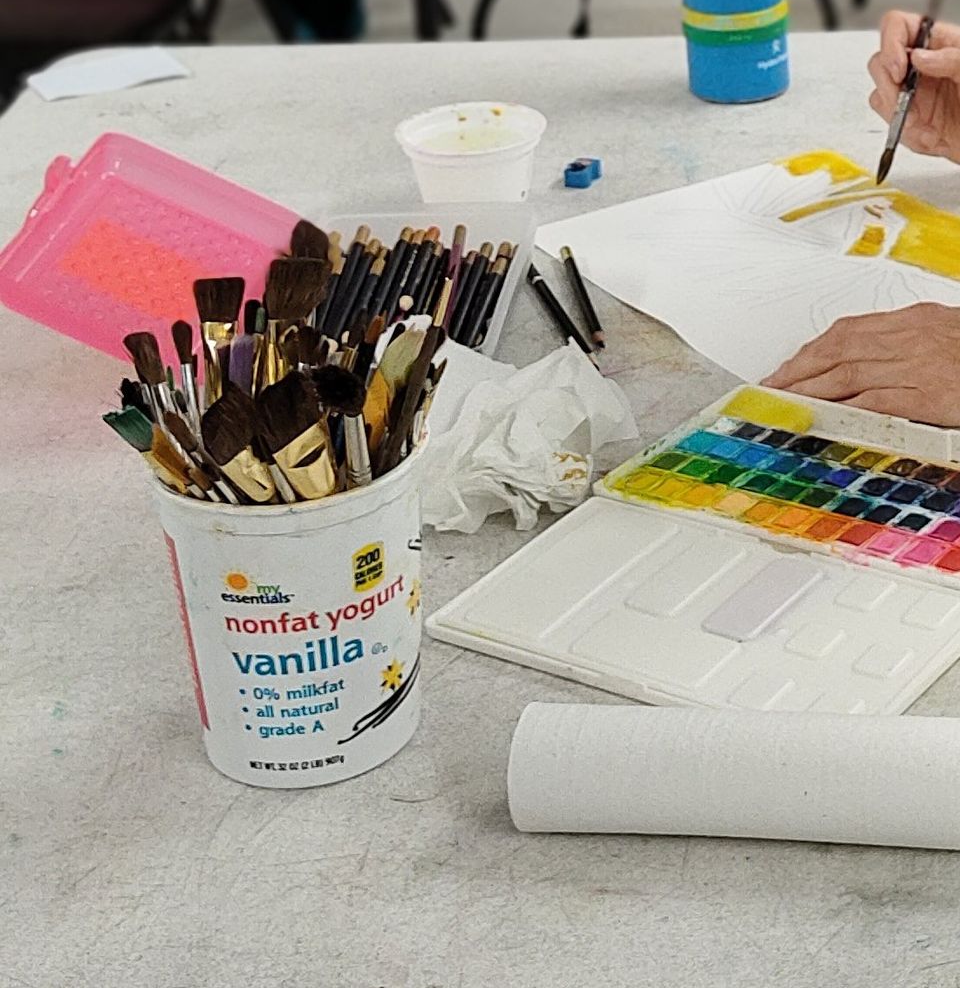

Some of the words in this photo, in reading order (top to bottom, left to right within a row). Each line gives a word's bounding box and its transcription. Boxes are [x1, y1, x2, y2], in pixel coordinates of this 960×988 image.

[355, 547, 380, 570] 200
[221, 591, 291, 604] essentials
[256, 584, 281, 596] my
[224, 611, 320, 634] nonfat
[325, 574, 404, 631] yogurt
[231, 635, 365, 676] vanilla
[253, 687, 280, 700] 0%
[286, 679, 344, 700] milkfat
[256, 705, 274, 718] all
[280, 697, 339, 718] natural
[258, 722, 305, 738] grade
[312, 720, 324, 733] A
